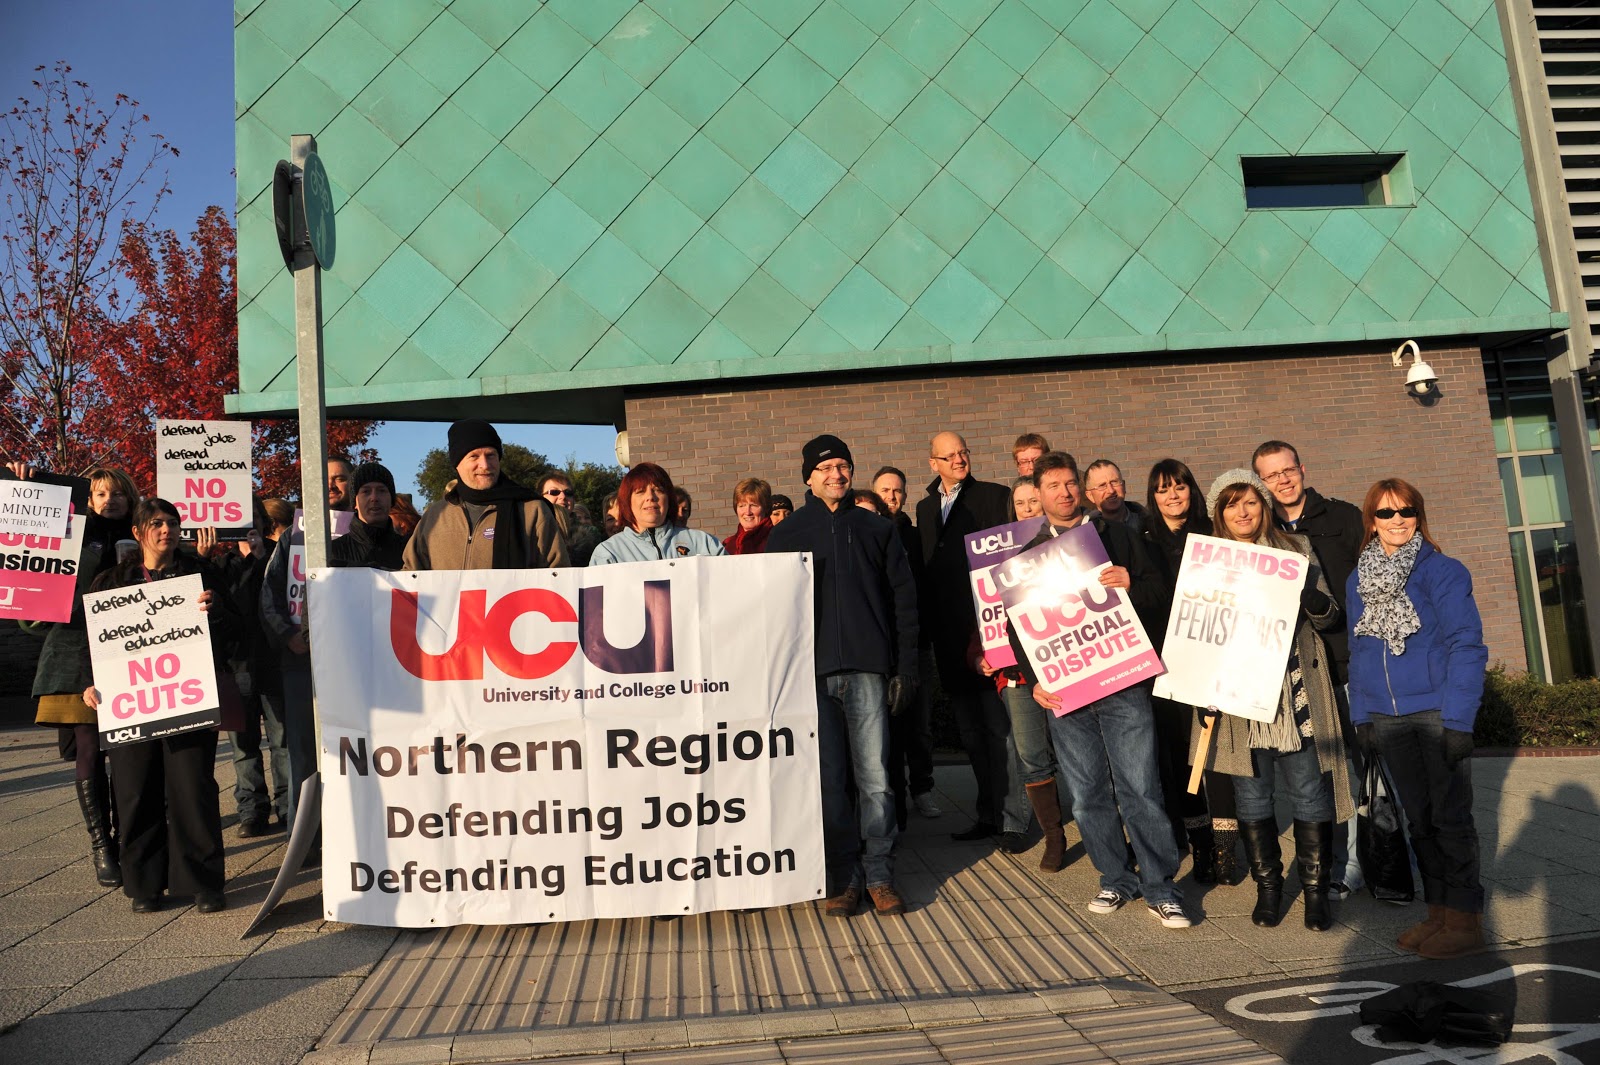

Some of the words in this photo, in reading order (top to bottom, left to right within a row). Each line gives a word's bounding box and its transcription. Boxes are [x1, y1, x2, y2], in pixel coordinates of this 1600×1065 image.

[162, 424, 206, 436] defend
[204, 433, 236, 446] jobs
[165, 448, 209, 460] defend
[184, 459, 247, 471] education
[11, 487, 44, 500] NOT
[185, 478, 227, 498] NO
[2, 503, 62, 518] MINUTE
[11, 518, 28, 527] THE
[173, 502, 243, 523] CUTS
[1190, 541, 1300, 581] HANDS
[91, 588, 147, 614] defend
[145, 595, 185, 615] jobs
[98, 618, 154, 643] defend
[124, 625, 203, 651] education
[1035, 610, 1132, 663] OFFICIAL
[1174, 599, 1288, 653] PENSINS
[1041, 626, 1142, 684] DISPUTE
[128, 653, 181, 686] NO
[1099, 659, 1152, 687] www.ucu.org.uk
[112, 678, 205, 719] CUTS
[483, 686, 571, 703] University
[574, 684, 605, 699] and
[609, 682, 676, 698] College
[681, 679, 729, 694] Union
[339, 733, 583, 777] Northern
[606, 722, 795, 775] Region
[387, 799, 623, 841] Defending
[641, 793, 746, 830] Jobs
[350, 858, 565, 897] Defending
[584, 845, 796, 886] Education
